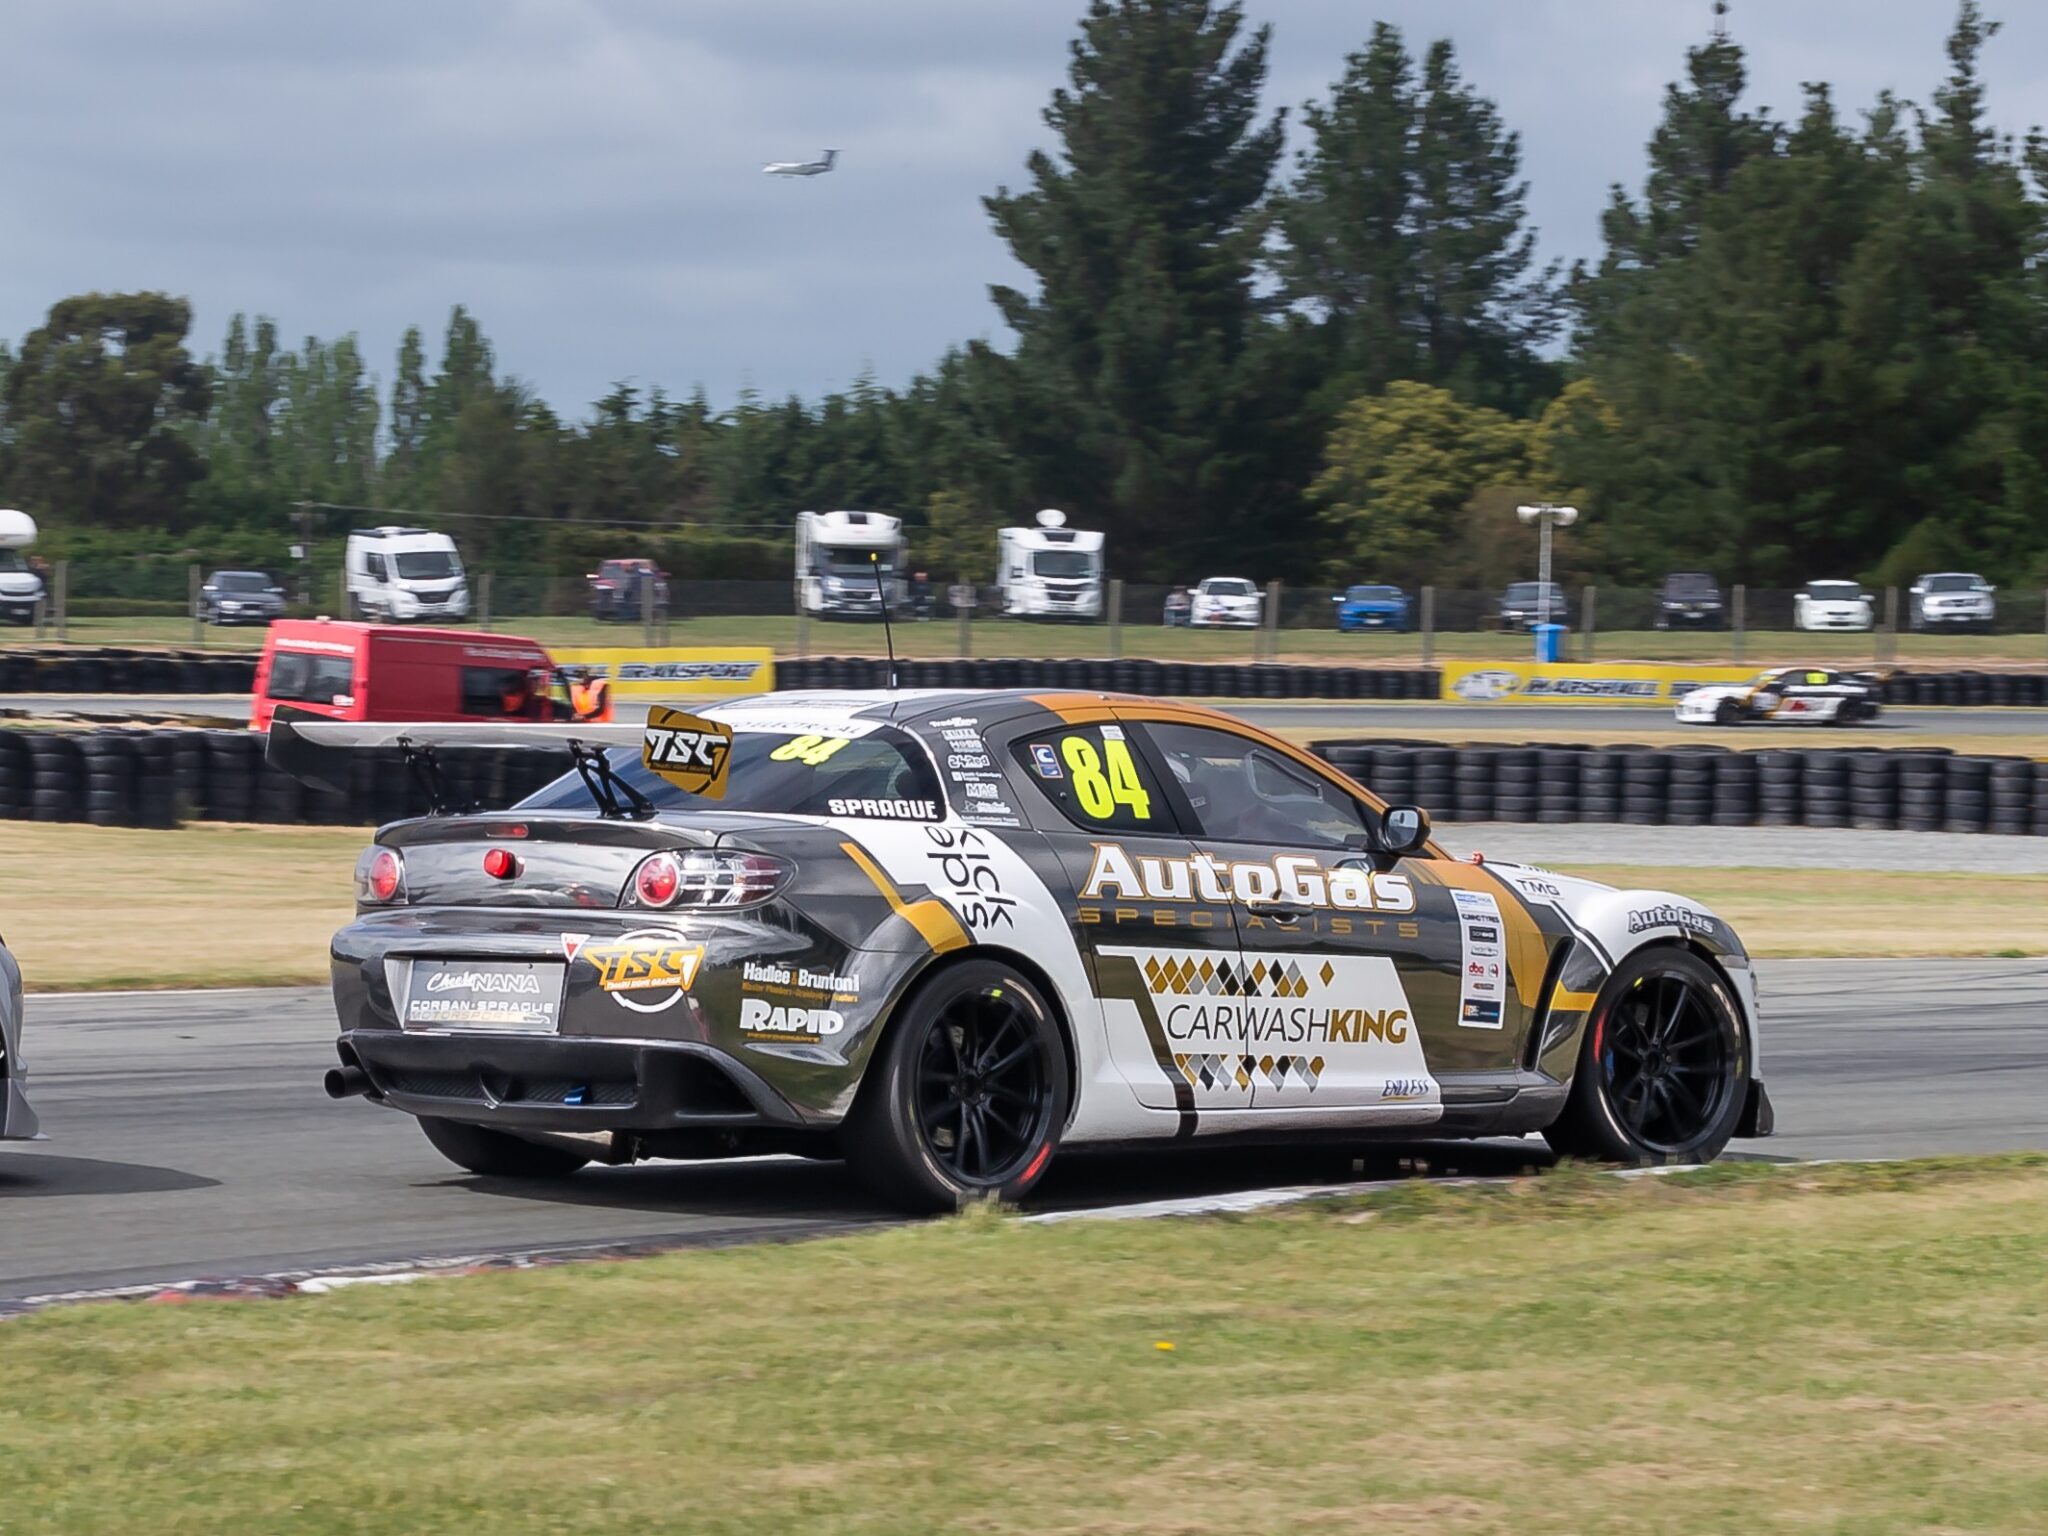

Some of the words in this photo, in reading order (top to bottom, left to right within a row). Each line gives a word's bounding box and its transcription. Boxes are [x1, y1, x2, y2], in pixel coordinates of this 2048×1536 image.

[769, 735, 851, 766] 84
[1061, 736, 1151, 819] 84
[828, 799, 938, 819] SPRAGUE
[1080, 842, 1416, 913] AutoGas
[1515, 879, 1560, 896] TMG
[1628, 905, 1716, 934] AutoGas
[471, 973, 540, 993] NANA
[743, 962, 790, 985] Hadlee
[739, 998, 844, 1035] RAPID
[1382, 1079, 1429, 1097] ENDLESS
